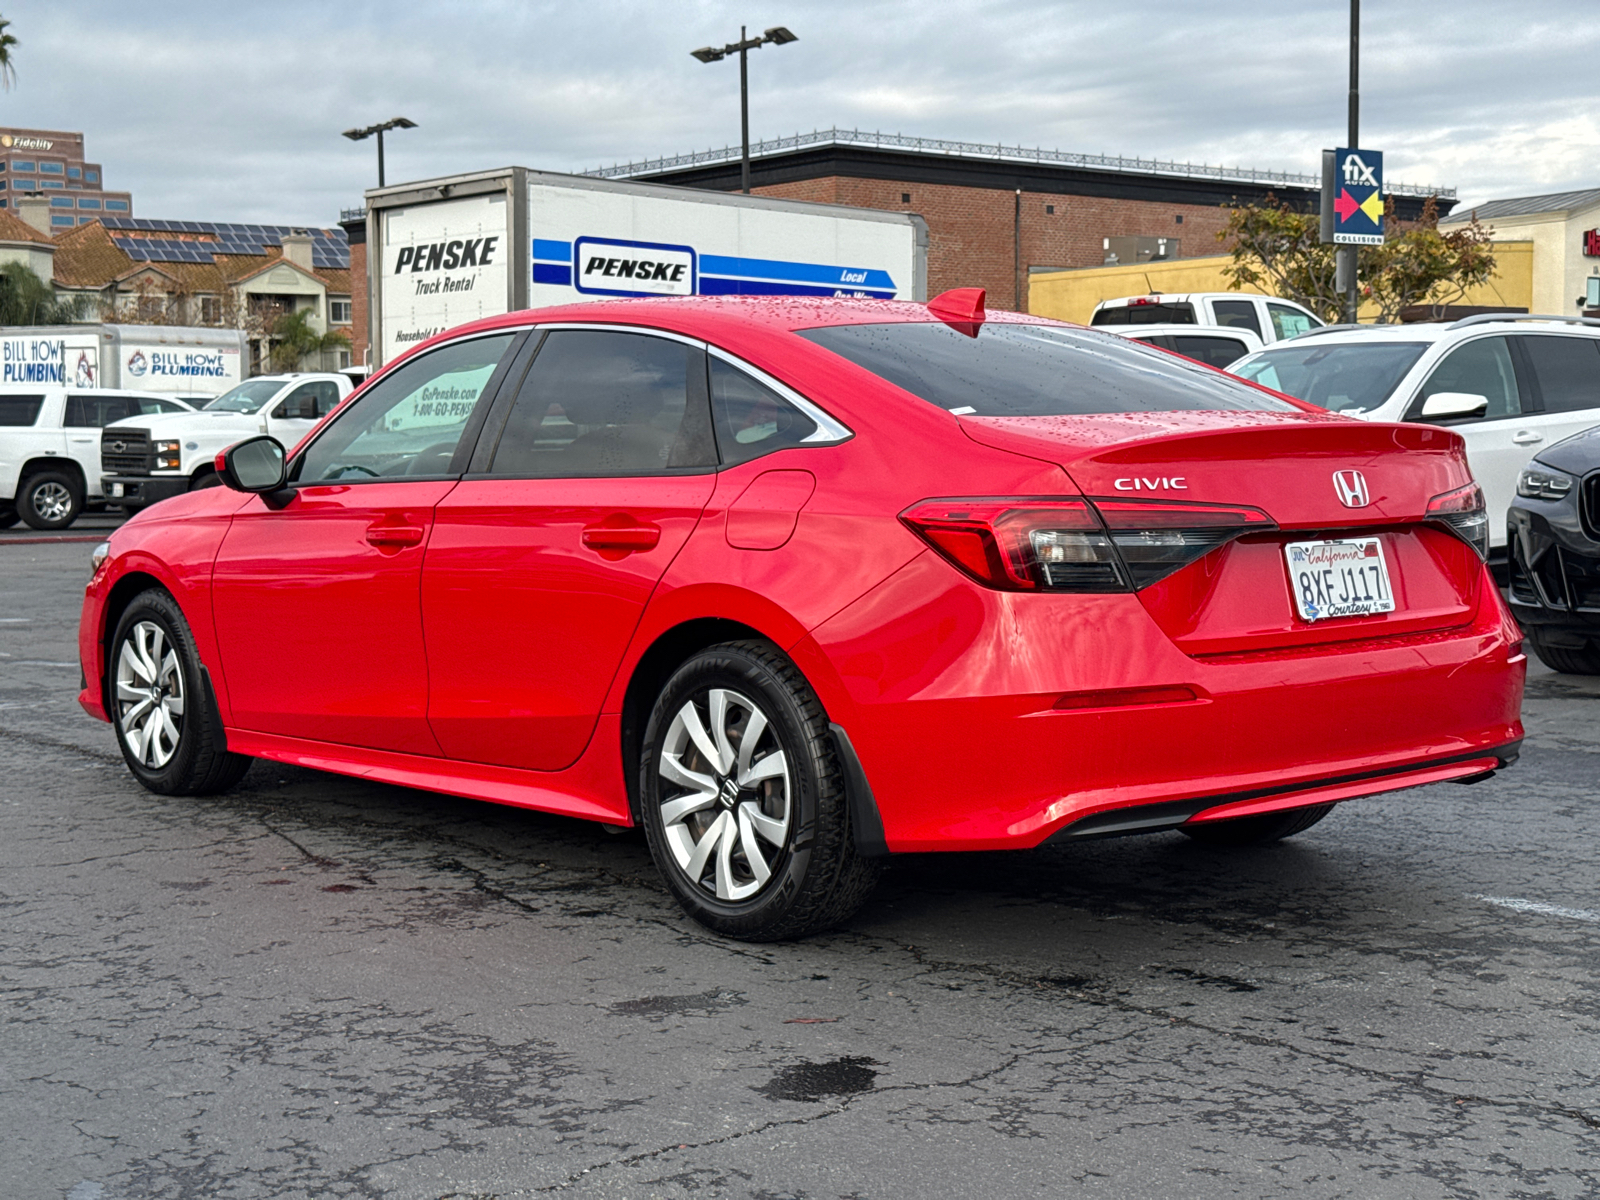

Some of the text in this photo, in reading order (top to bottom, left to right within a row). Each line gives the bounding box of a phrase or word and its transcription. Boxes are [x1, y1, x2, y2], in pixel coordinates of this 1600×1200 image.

[13, 137, 54, 151] Fidelity
[1342, 153, 1380, 188] fix
[1335, 235, 1383, 243] COLLISION
[394, 236, 499, 275] PENSKE
[584, 256, 688, 282] PENSKE
[840, 269, 868, 284] Local
[415, 273, 476, 296] Truck Rental
[395, 327, 432, 343] Household
[4, 340, 61, 361] BILL HOW
[152, 353, 225, 367] BILL HOWE
[151, 365, 225, 377] PLUMBING
[422, 386, 477, 401] GoPenske.com
[1114, 477, 1188, 490] CIVIC
[1308, 546, 1366, 568] California
[1300, 565, 1383, 608] 8XFJ117
[1327, 603, 1371, 617] Courtesy
